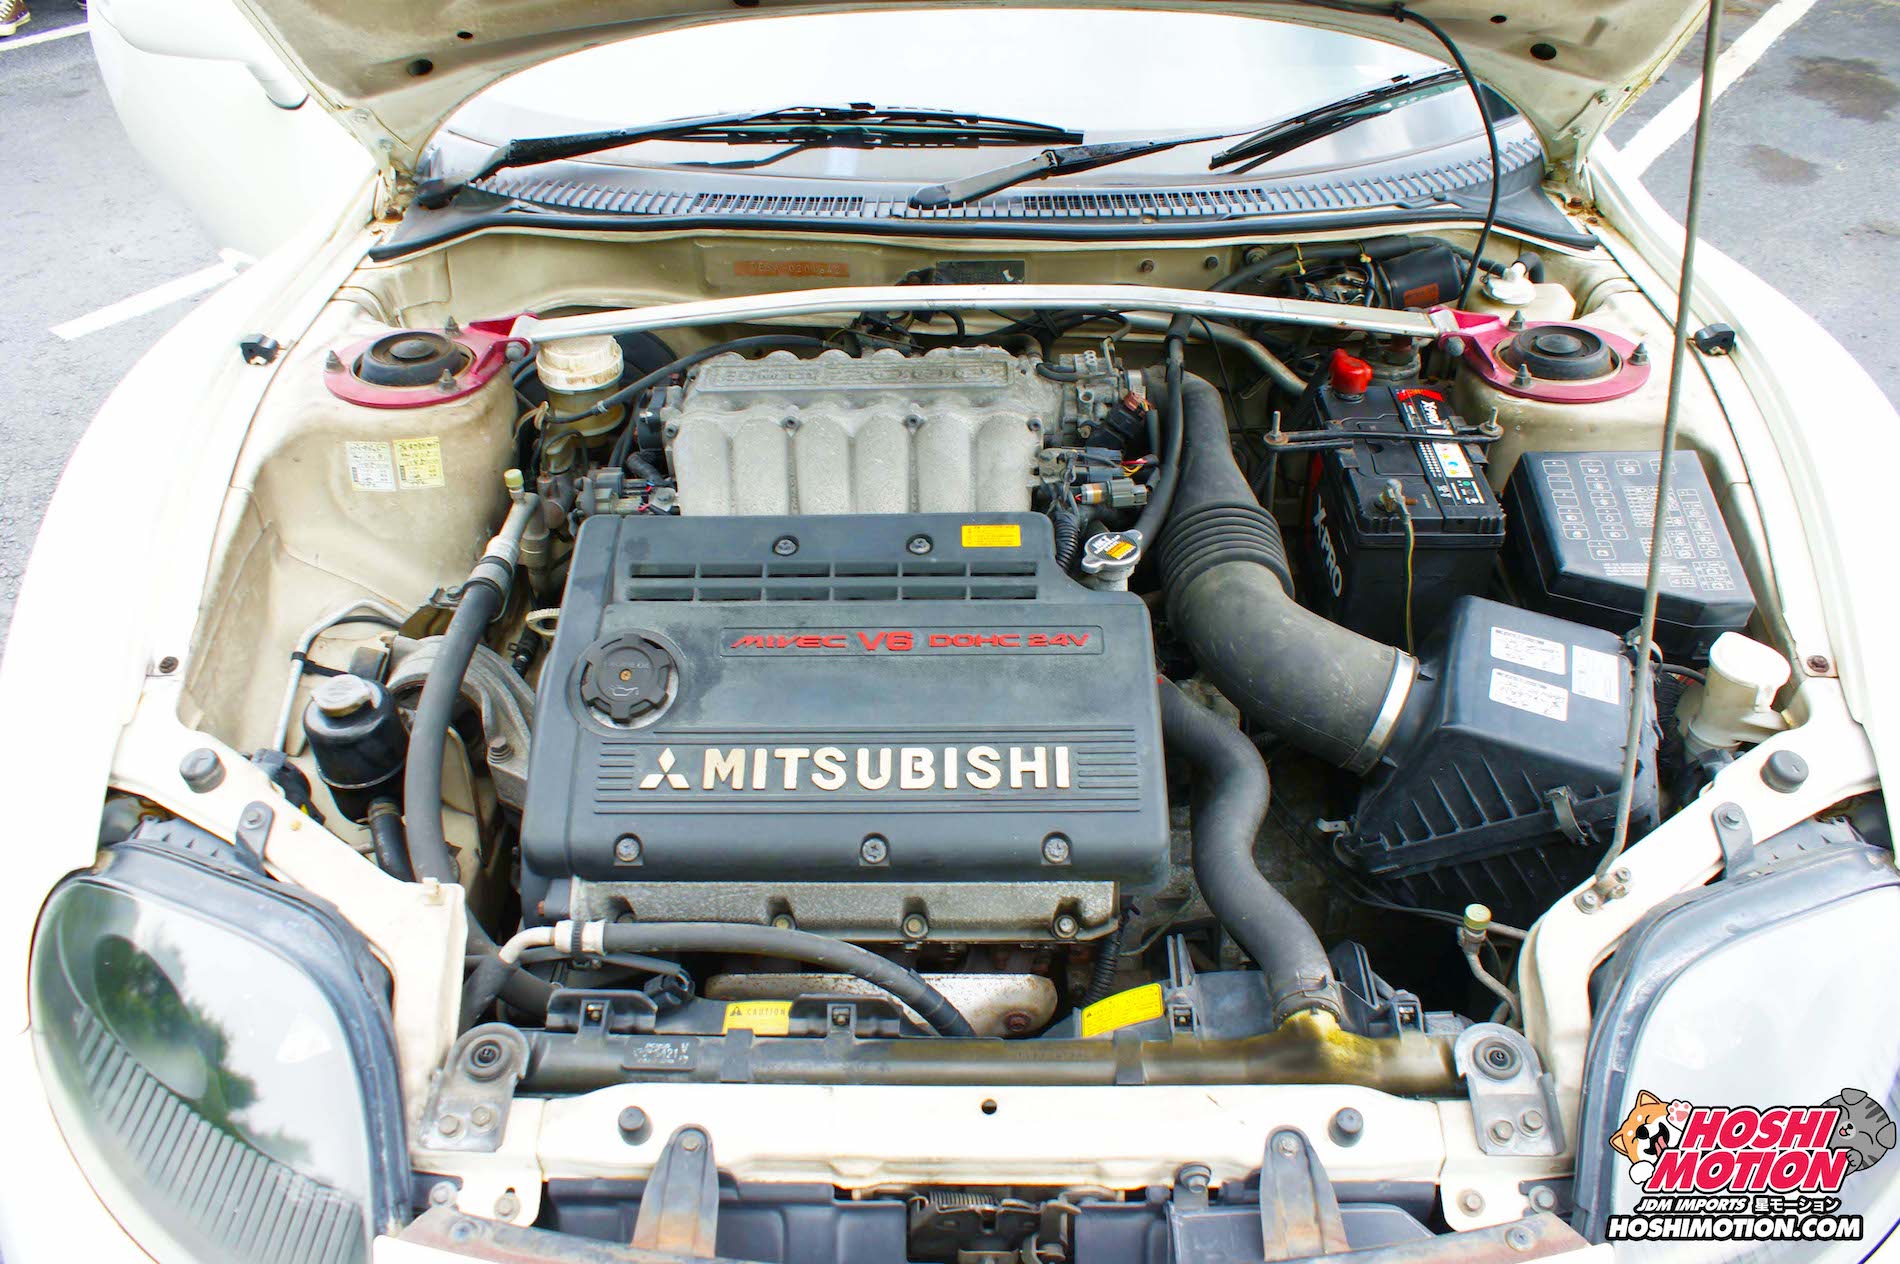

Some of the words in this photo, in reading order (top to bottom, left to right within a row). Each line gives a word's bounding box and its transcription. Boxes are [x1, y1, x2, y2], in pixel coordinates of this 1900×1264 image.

[730, 635, 847, 649] MIVEC
[857, 631, 914, 652] V6
[929, 634, 1020, 648] DOHC
[1027, 633, 1090, 647] 24V
[702, 745, 1071, 791] MITSUBISHI
[746, 1007, 786, 1016] CAUTION
